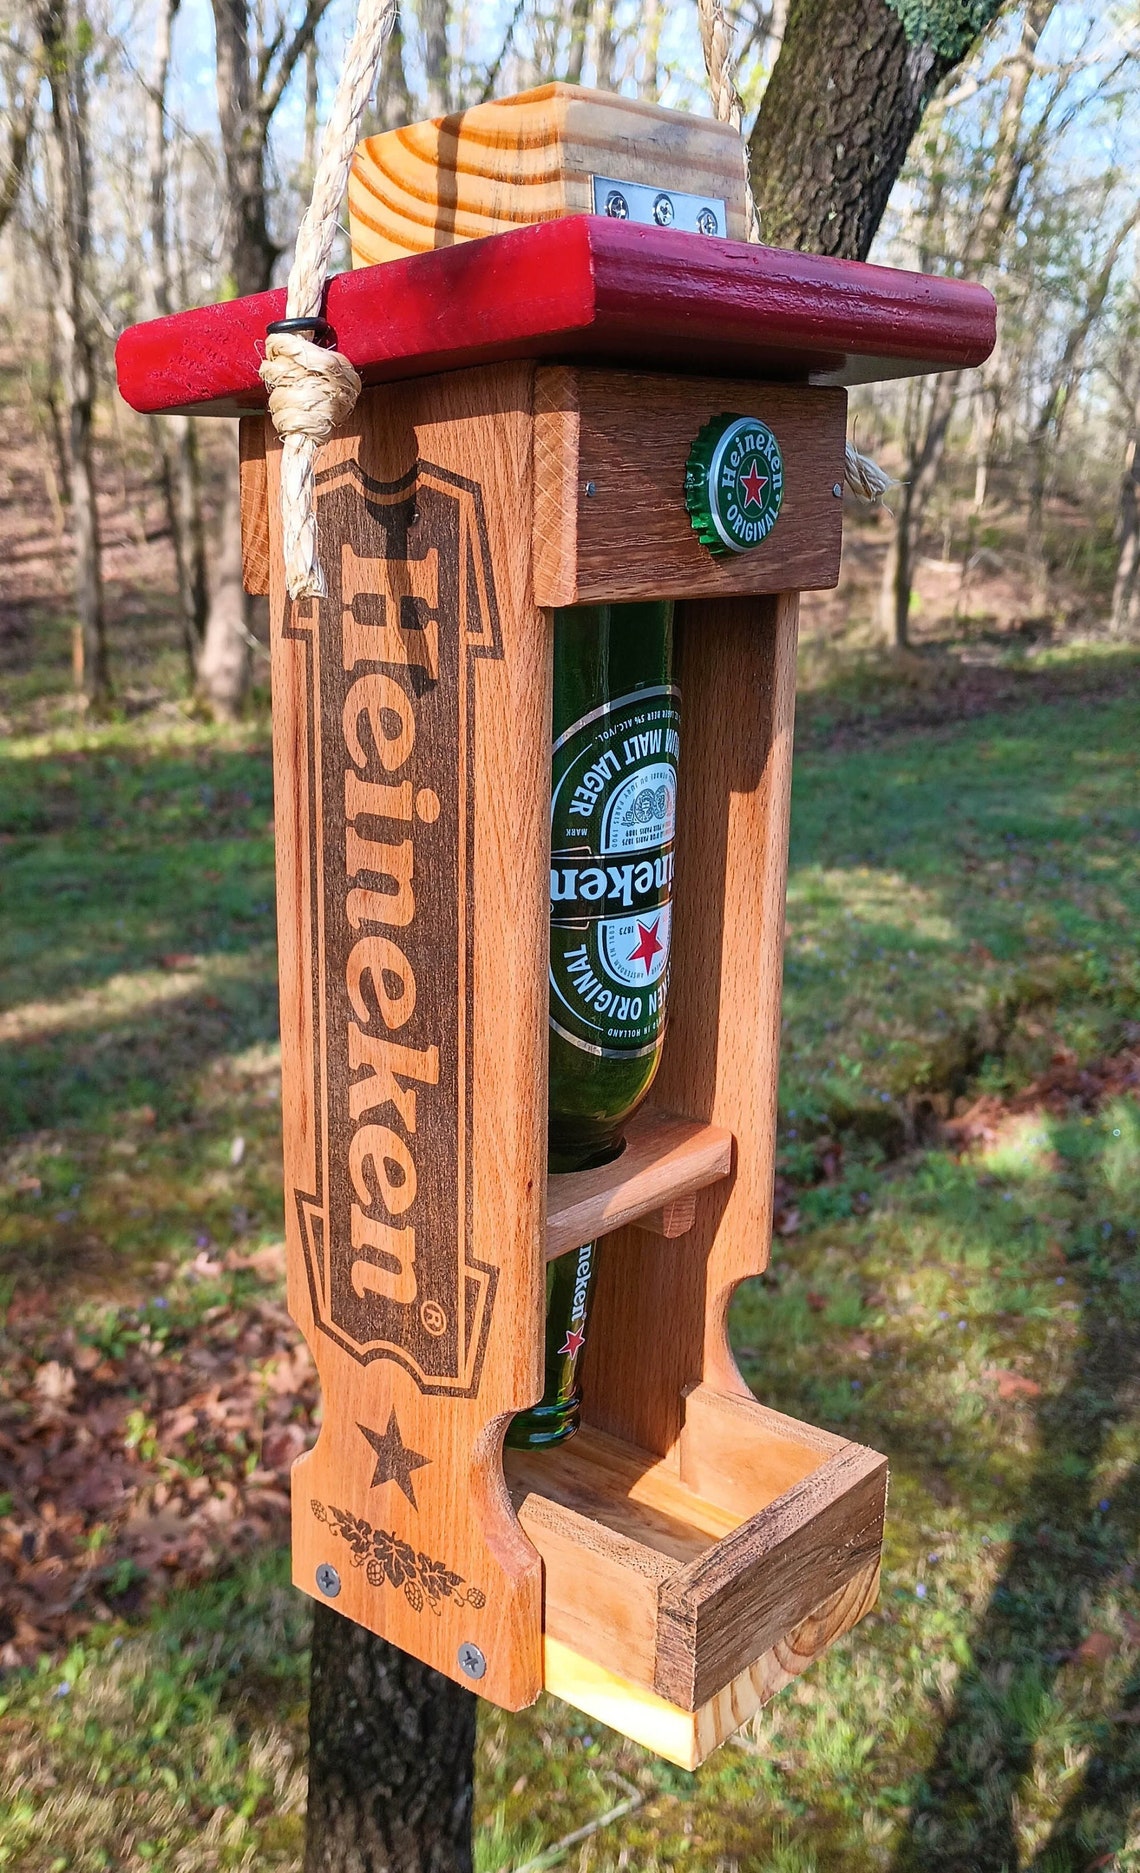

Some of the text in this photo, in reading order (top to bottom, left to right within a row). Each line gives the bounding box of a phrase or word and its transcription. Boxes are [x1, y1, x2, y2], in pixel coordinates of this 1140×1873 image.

[722, 432, 783, 490] Heineken
[727, 504, 778, 542] ORIGINAL
[634, 714, 645, 724] 5%
[622, 729, 662, 765] MALT
[568, 750, 622, 817] LAGER
[565, 828, 588, 837] MARK
[619, 926, 634, 935] 1873
[563, 943, 642, 1021] ORIGINAL
[607, 1028, 640, 1037] HOLLAND
[572, 1244, 592, 1321] neken
